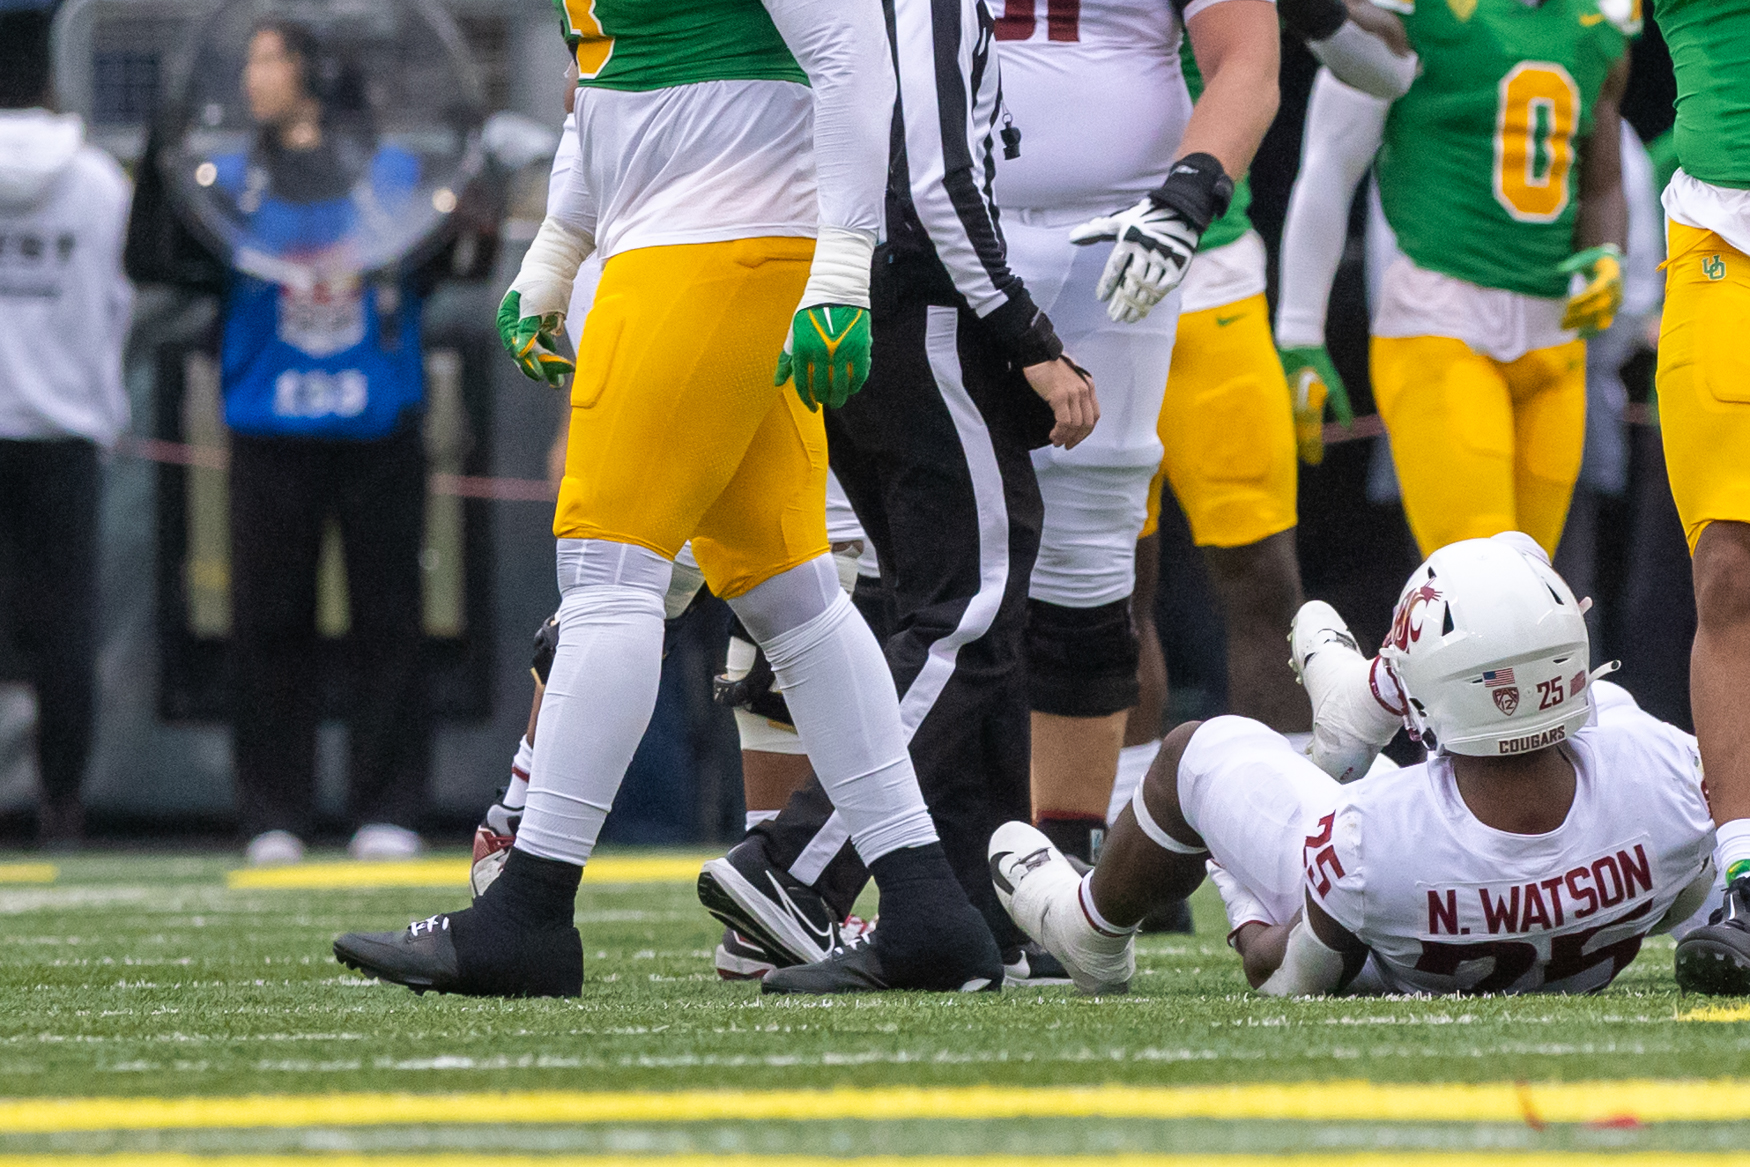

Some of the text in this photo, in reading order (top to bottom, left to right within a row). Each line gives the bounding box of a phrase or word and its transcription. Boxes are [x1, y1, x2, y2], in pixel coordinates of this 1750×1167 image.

[1493, 60, 1581, 224] 0
[1501, 699, 1515, 711] 12
[1536, 675, 1564, 711] 25
[1499, 724, 1566, 754] COUGARS
[1427, 844, 1654, 936] N. WATSON
